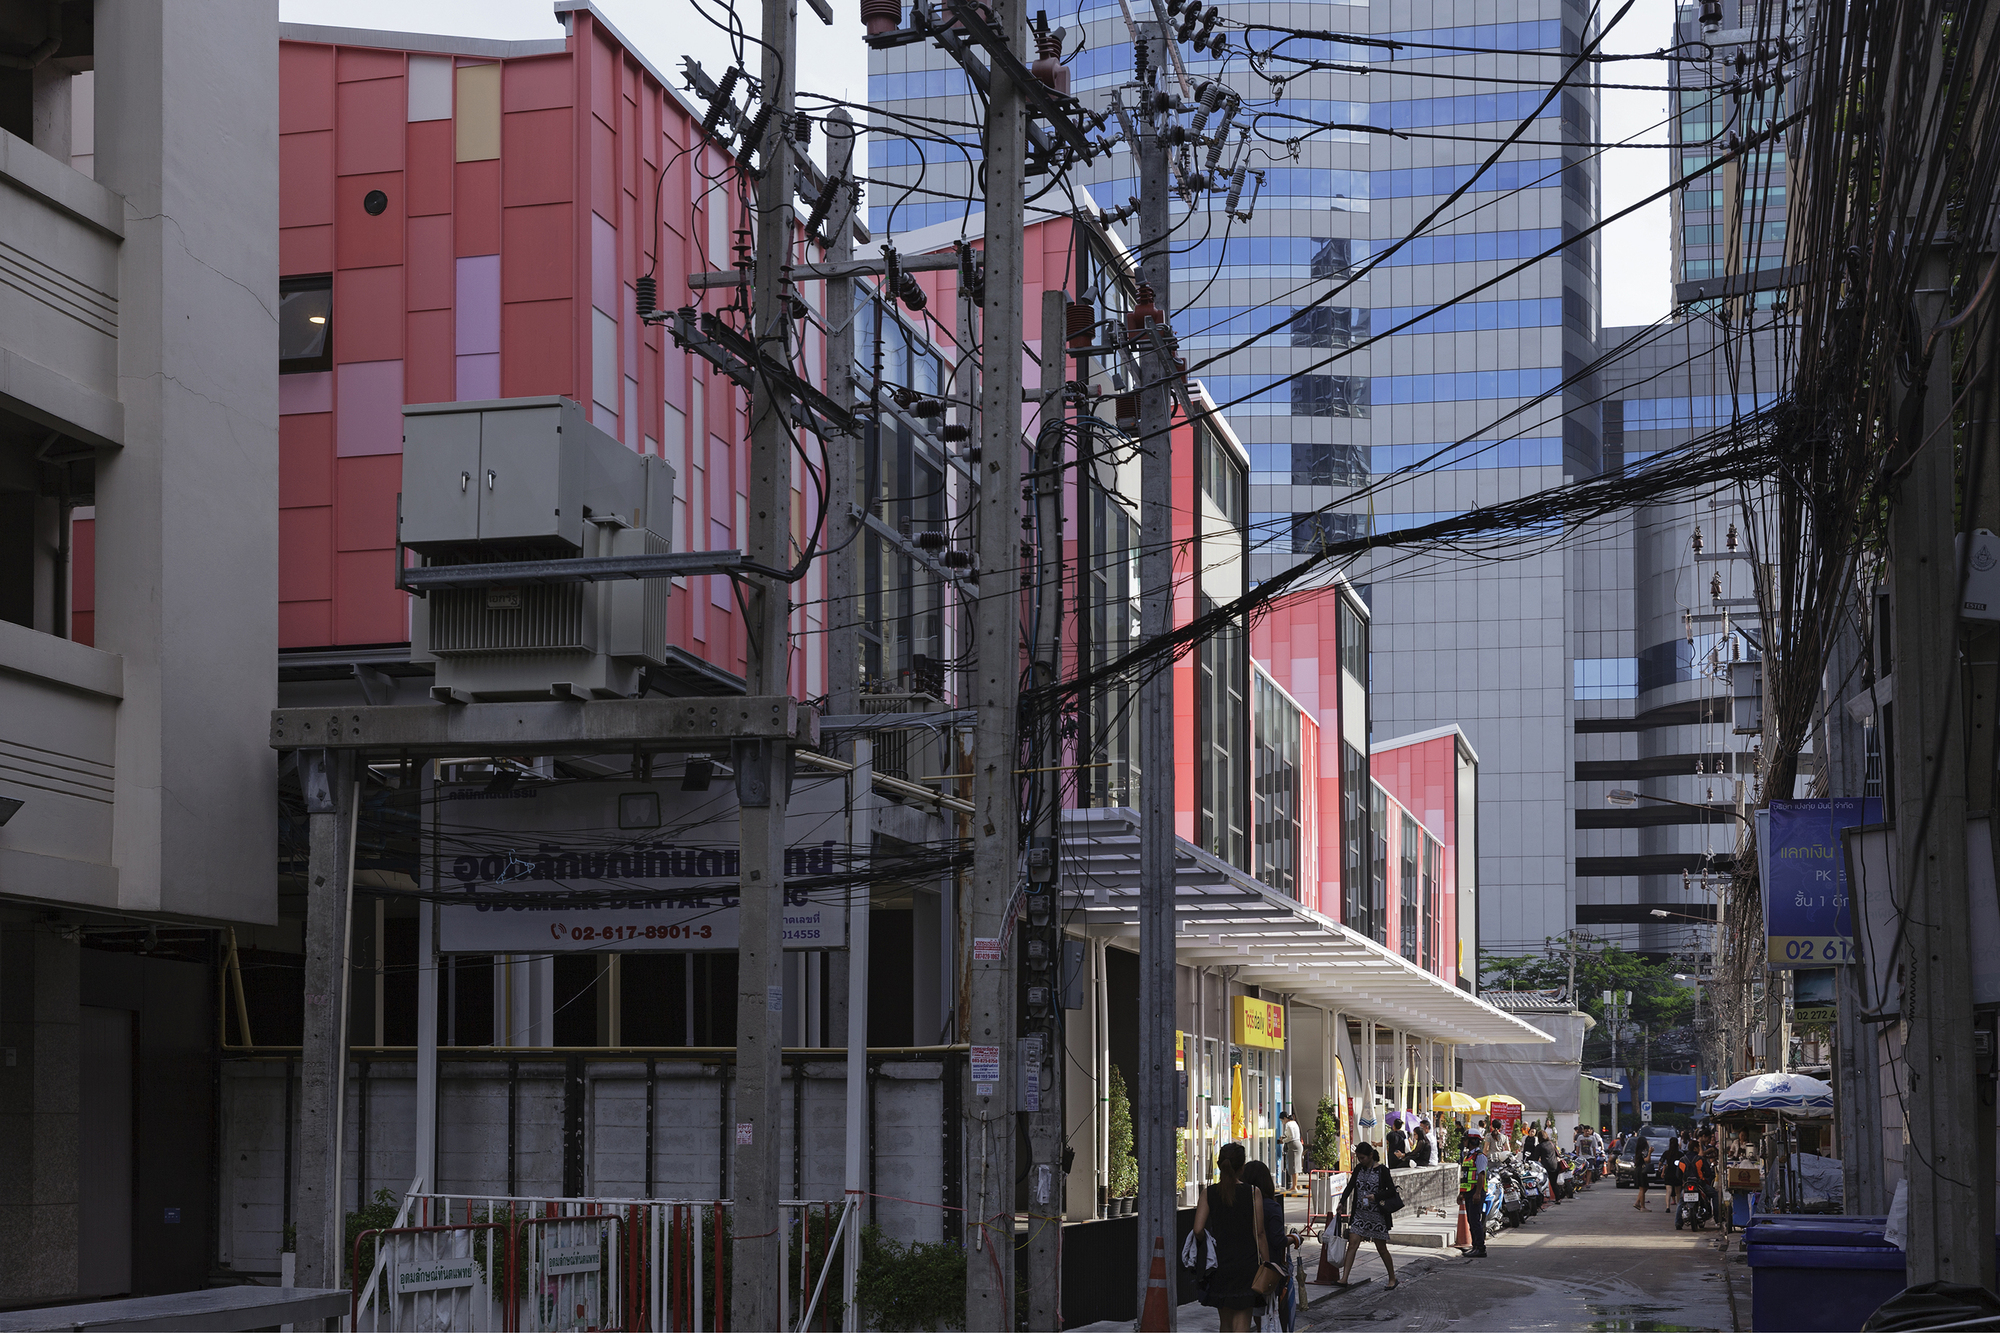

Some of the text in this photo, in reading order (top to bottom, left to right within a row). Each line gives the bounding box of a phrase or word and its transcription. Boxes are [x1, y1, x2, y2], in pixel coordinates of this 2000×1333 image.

[1835, 801, 1854, 809] จำกัด
[1781, 844, 1834, 859] แลกเงิน
[1816, 870, 1832, 881] PK
[1795, 890, 1813, 907] ชั้น
[1820, 895, 1825, 907] 1
[571, 924, 712, 941] 02-617-8901-3
[1786, 940, 1814, 960] 02
[1797, 1012, 1808, 1021] 02
[1811, 1010, 1828, 1020] 272
[400, 1262, 473, 1290] อุดมลักษณ์ทันตแพทย์
